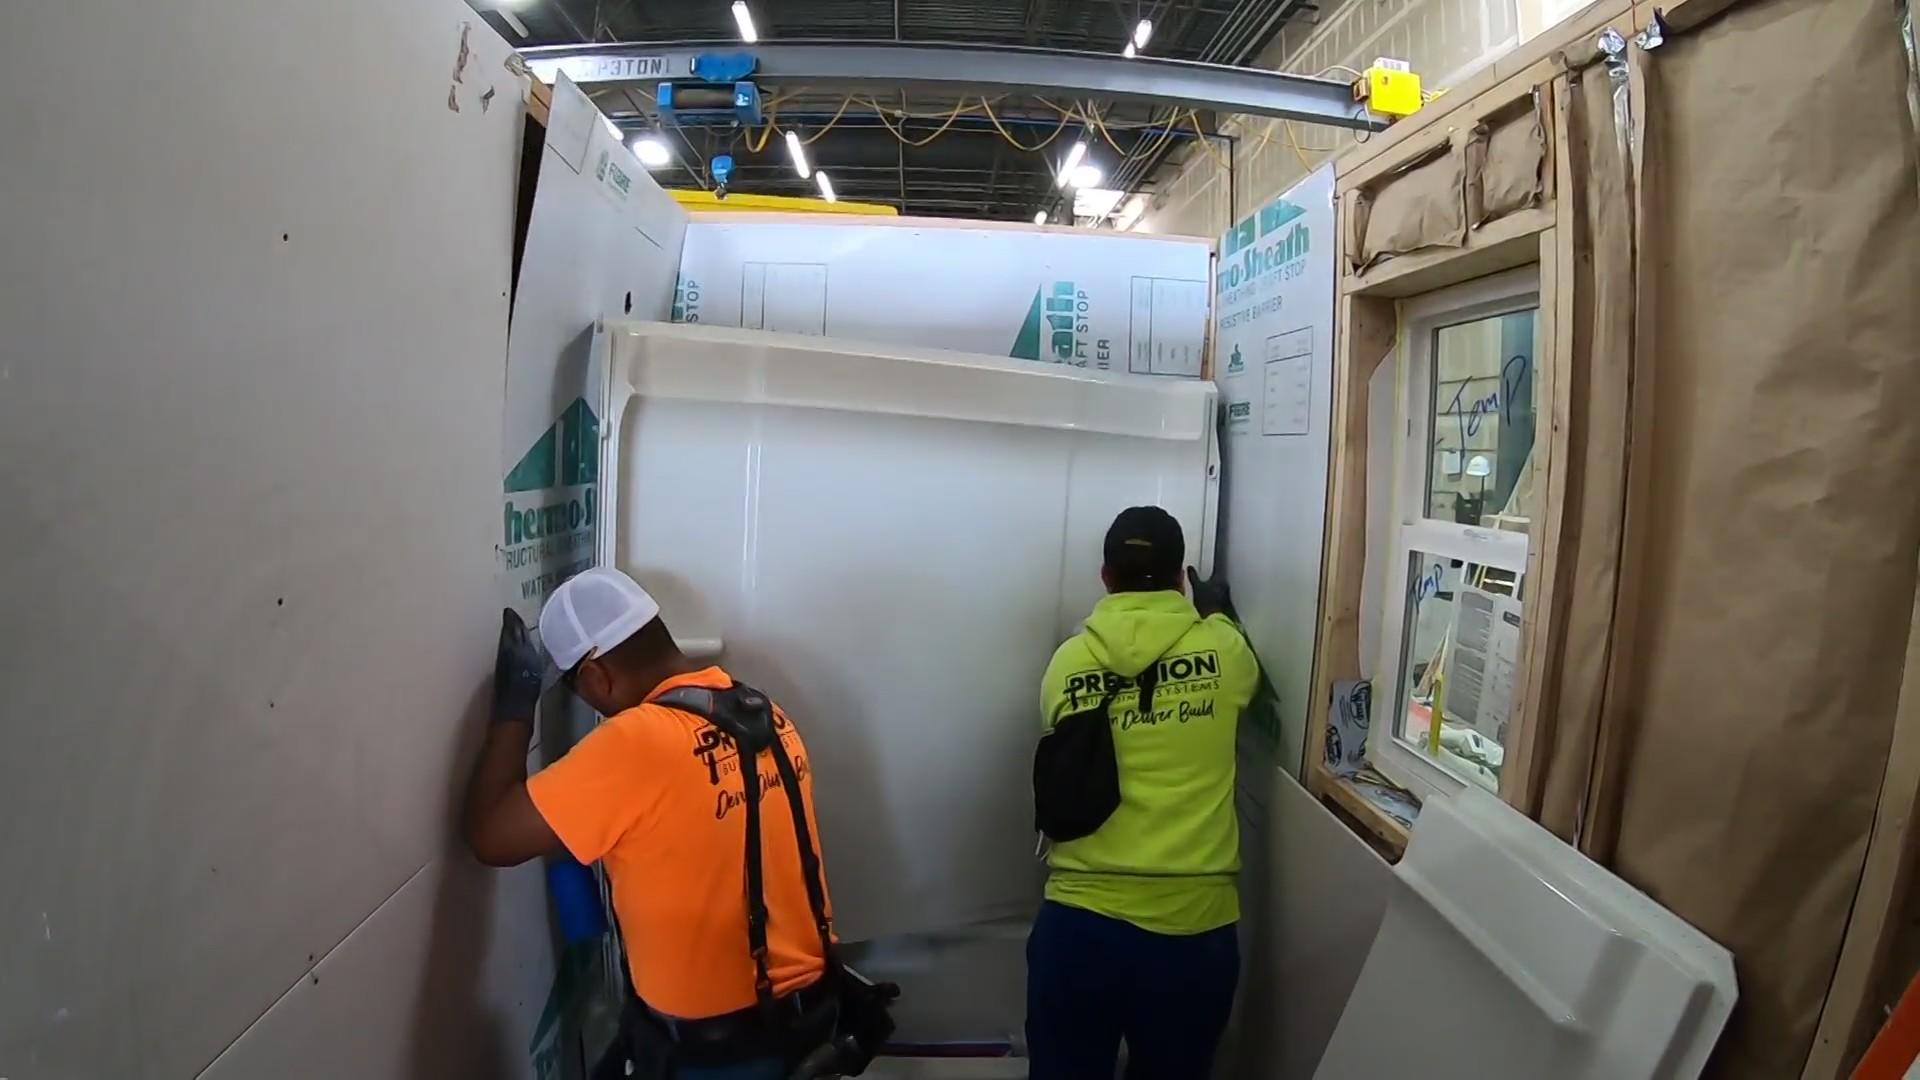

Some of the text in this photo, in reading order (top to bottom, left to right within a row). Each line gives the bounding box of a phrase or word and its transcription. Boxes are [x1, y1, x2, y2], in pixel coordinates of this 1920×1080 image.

[686, 280, 700, 324] STOP
[1075, 290, 1089, 333] STOP
[1156, 681, 1219, 698] SYSTEMS
[1179, 699, 1215, 724] Build
